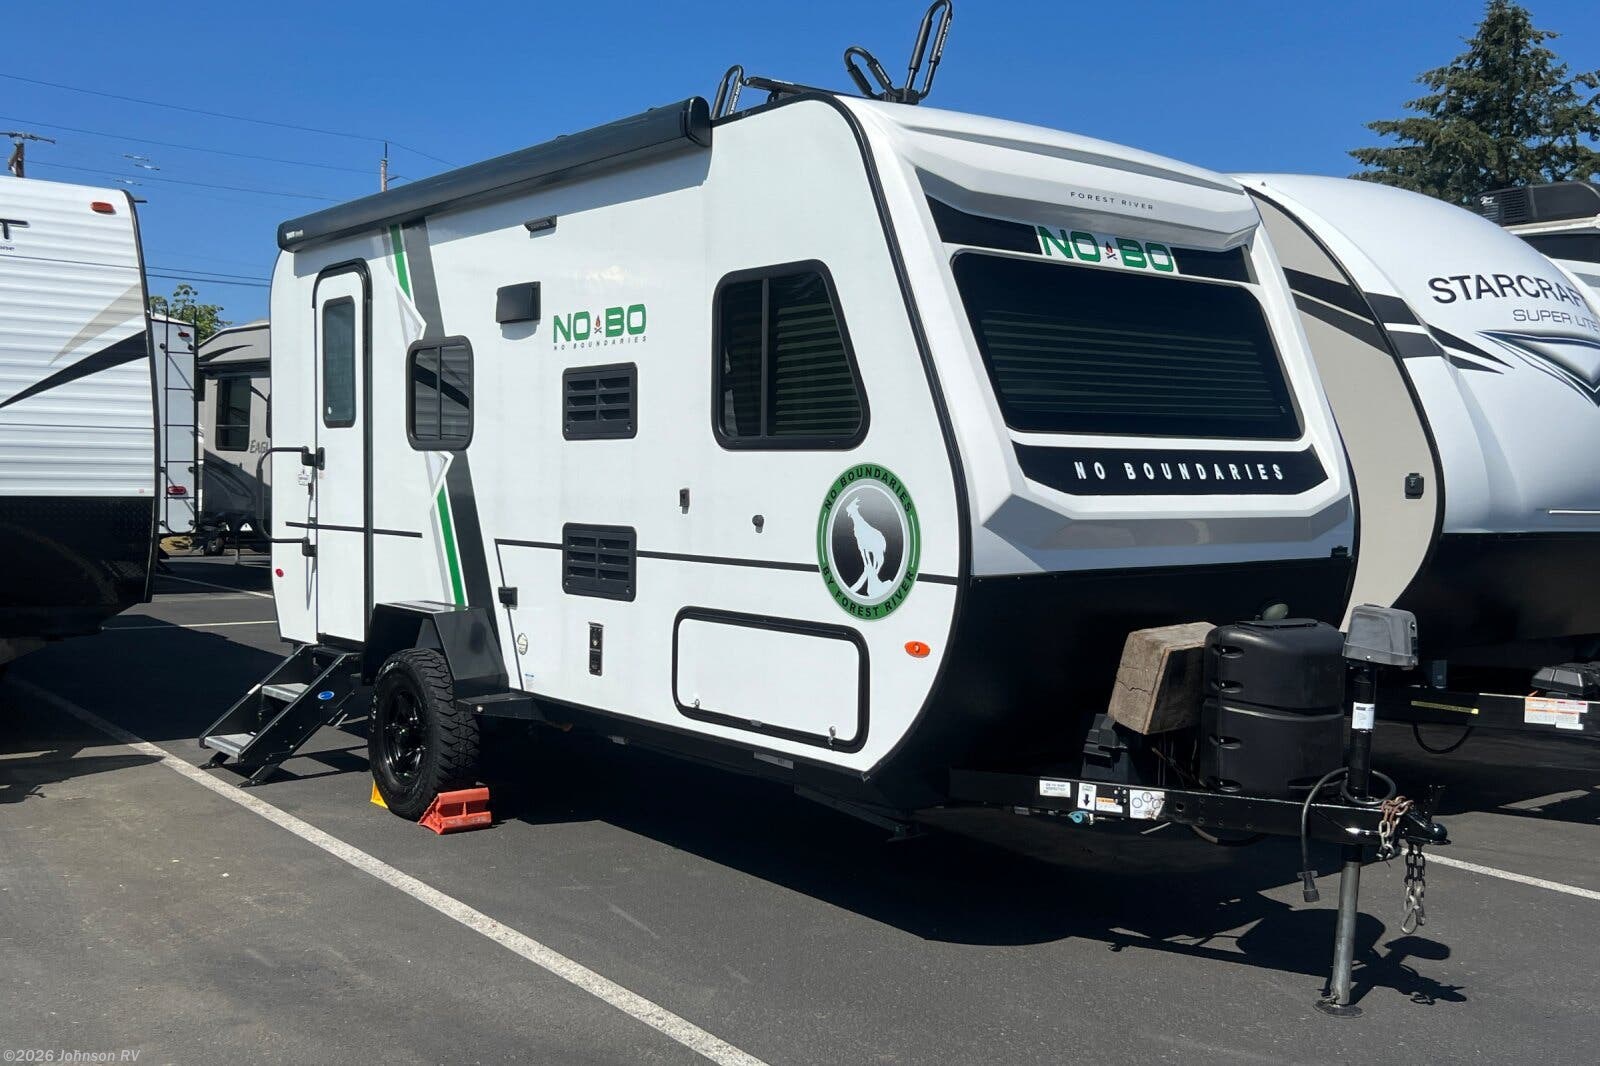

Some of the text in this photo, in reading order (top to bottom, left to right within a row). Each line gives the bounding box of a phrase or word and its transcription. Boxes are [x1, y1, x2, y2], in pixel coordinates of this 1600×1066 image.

[1070, 191, 1154, 210] FOREST RIVER
[1037, 225, 1173, 272] NO BO
[1428, 274, 1584, 307] STARCRAF
[553, 304, 647, 344] NO BO
[1512, 309, 1573, 325] SUPER
[573, 336, 647, 349] BOUNDARIES
[249, 440, 270, 454] EAGL
[1073, 461, 1283, 480] NO BOUNDARIES
[824, 466, 912, 513] NO BOUNDARIES
[822, 566, 914, 618] BY FOREST RIVER
